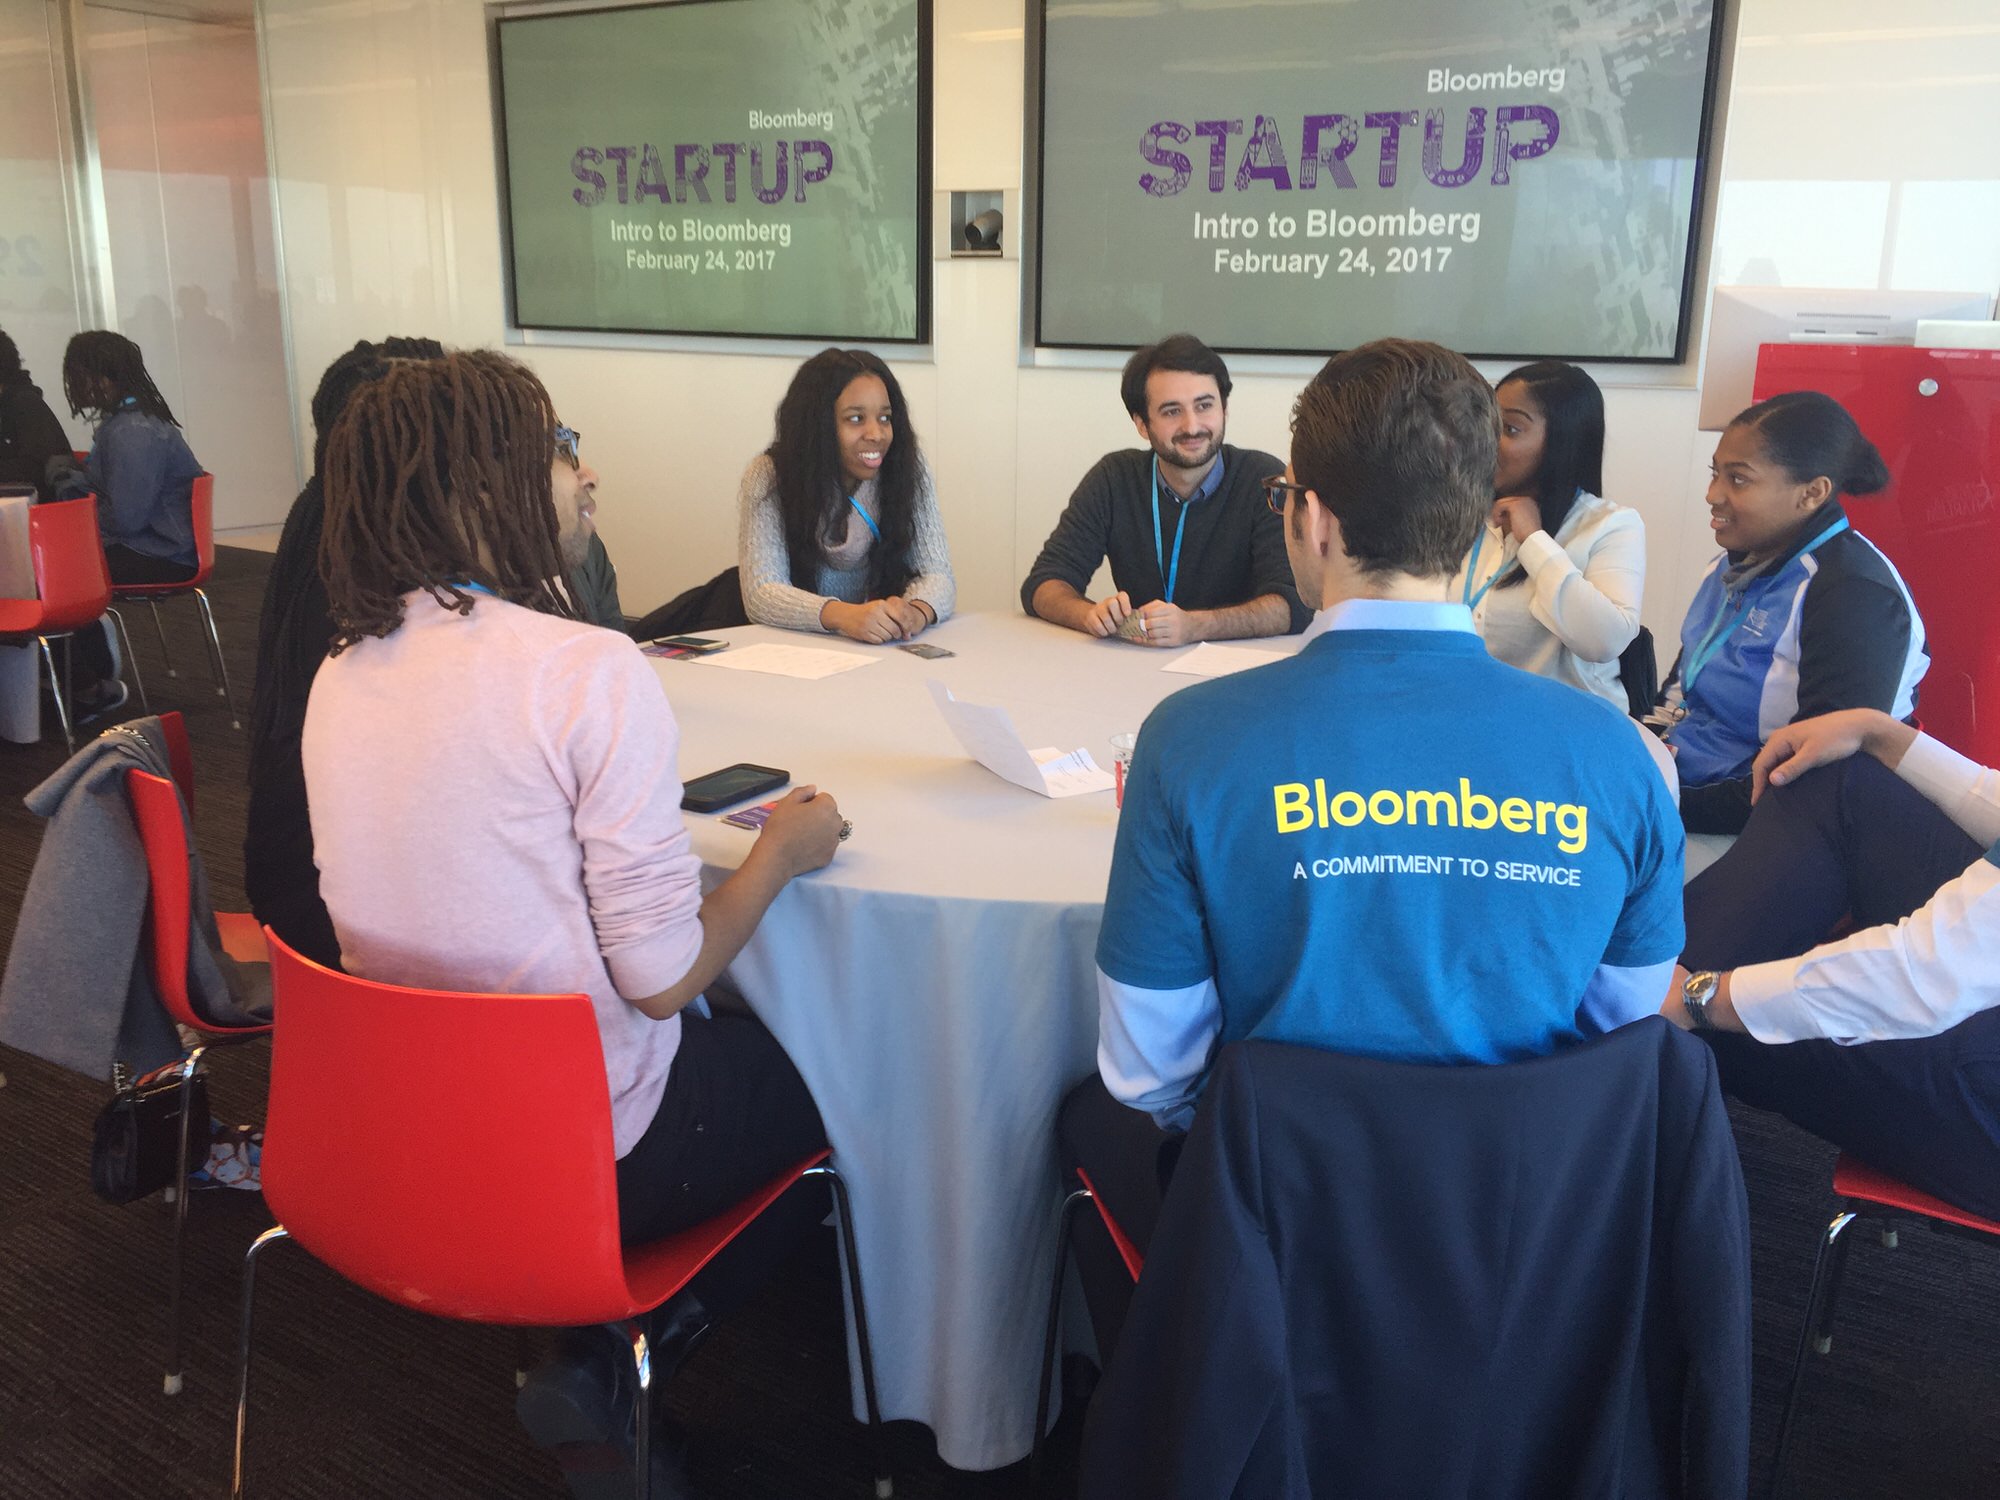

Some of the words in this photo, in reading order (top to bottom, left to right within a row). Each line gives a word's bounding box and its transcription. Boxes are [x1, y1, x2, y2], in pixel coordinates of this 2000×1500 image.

[1427, 65, 1567, 94] Bloomberg
[748, 108, 834, 131] Bloomberg
[1138, 104, 1561, 198] STARTUP
[571, 139, 833, 207] STARTUP
[610, 219, 653, 241] Intro
[658, 221, 678, 241] to
[682, 219, 792, 247] Bloomberg
[1193, 212, 1260, 240] Intro
[1268, 213, 1297, 239] to
[1306, 207, 1481, 243] Bloomberg
[625, 250, 700, 275] February
[704, 250, 730, 273] 24,
[735, 250, 776, 271] 2017
[1213, 248, 1329, 280] February
[1337, 247, 1376, 277] 24,
[1385, 246, 1452, 274] 2017
[1273, 777, 1588, 853] Bloomberg
[1293, 862, 1308, 880] A
[1312, 854, 1455, 878] COMMITMENT
[1458, 857, 1489, 877] TO
[1494, 862, 1582, 887] SERVICE
